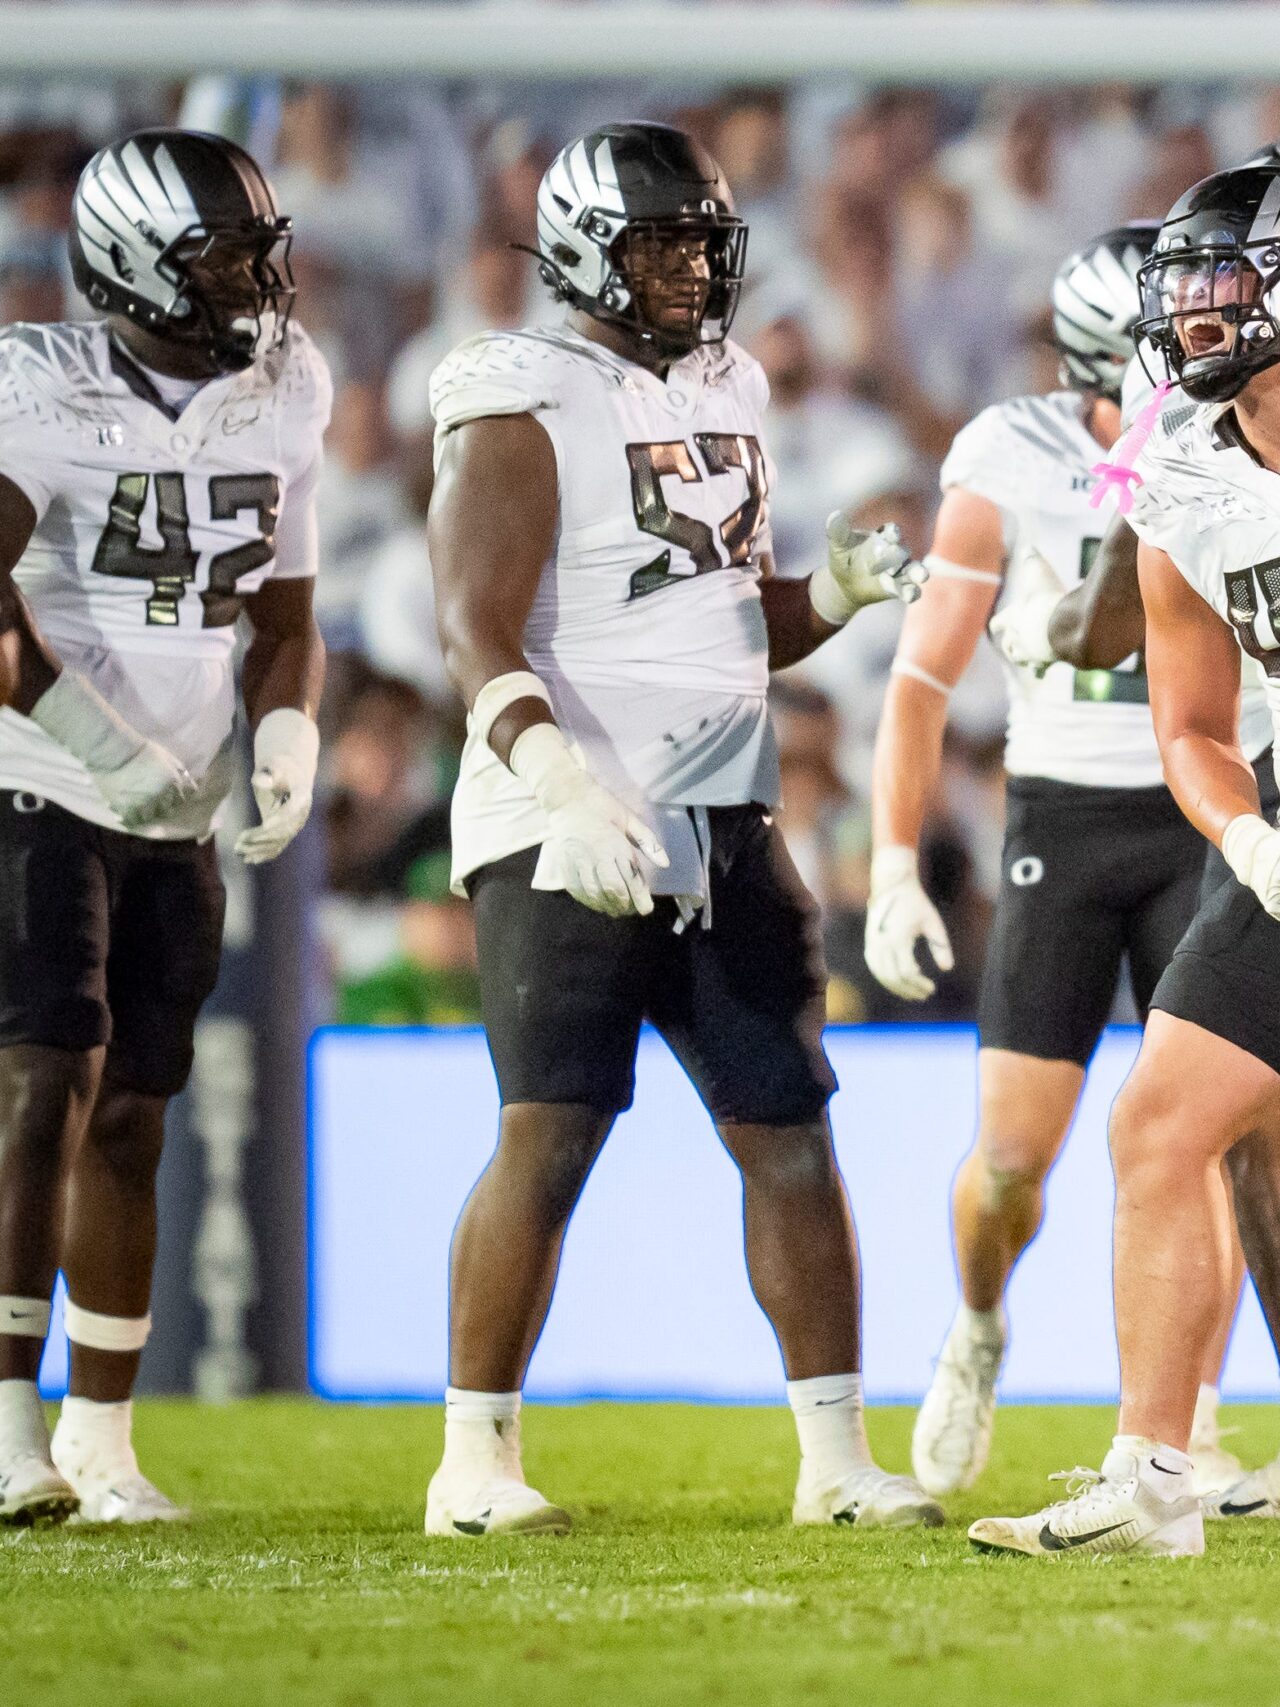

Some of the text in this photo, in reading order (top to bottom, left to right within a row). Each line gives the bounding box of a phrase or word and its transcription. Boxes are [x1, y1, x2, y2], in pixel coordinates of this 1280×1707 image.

[90, 470, 281, 630] 42
[625, 431, 769, 602] 57
[1010, 855, 1043, 887] O
